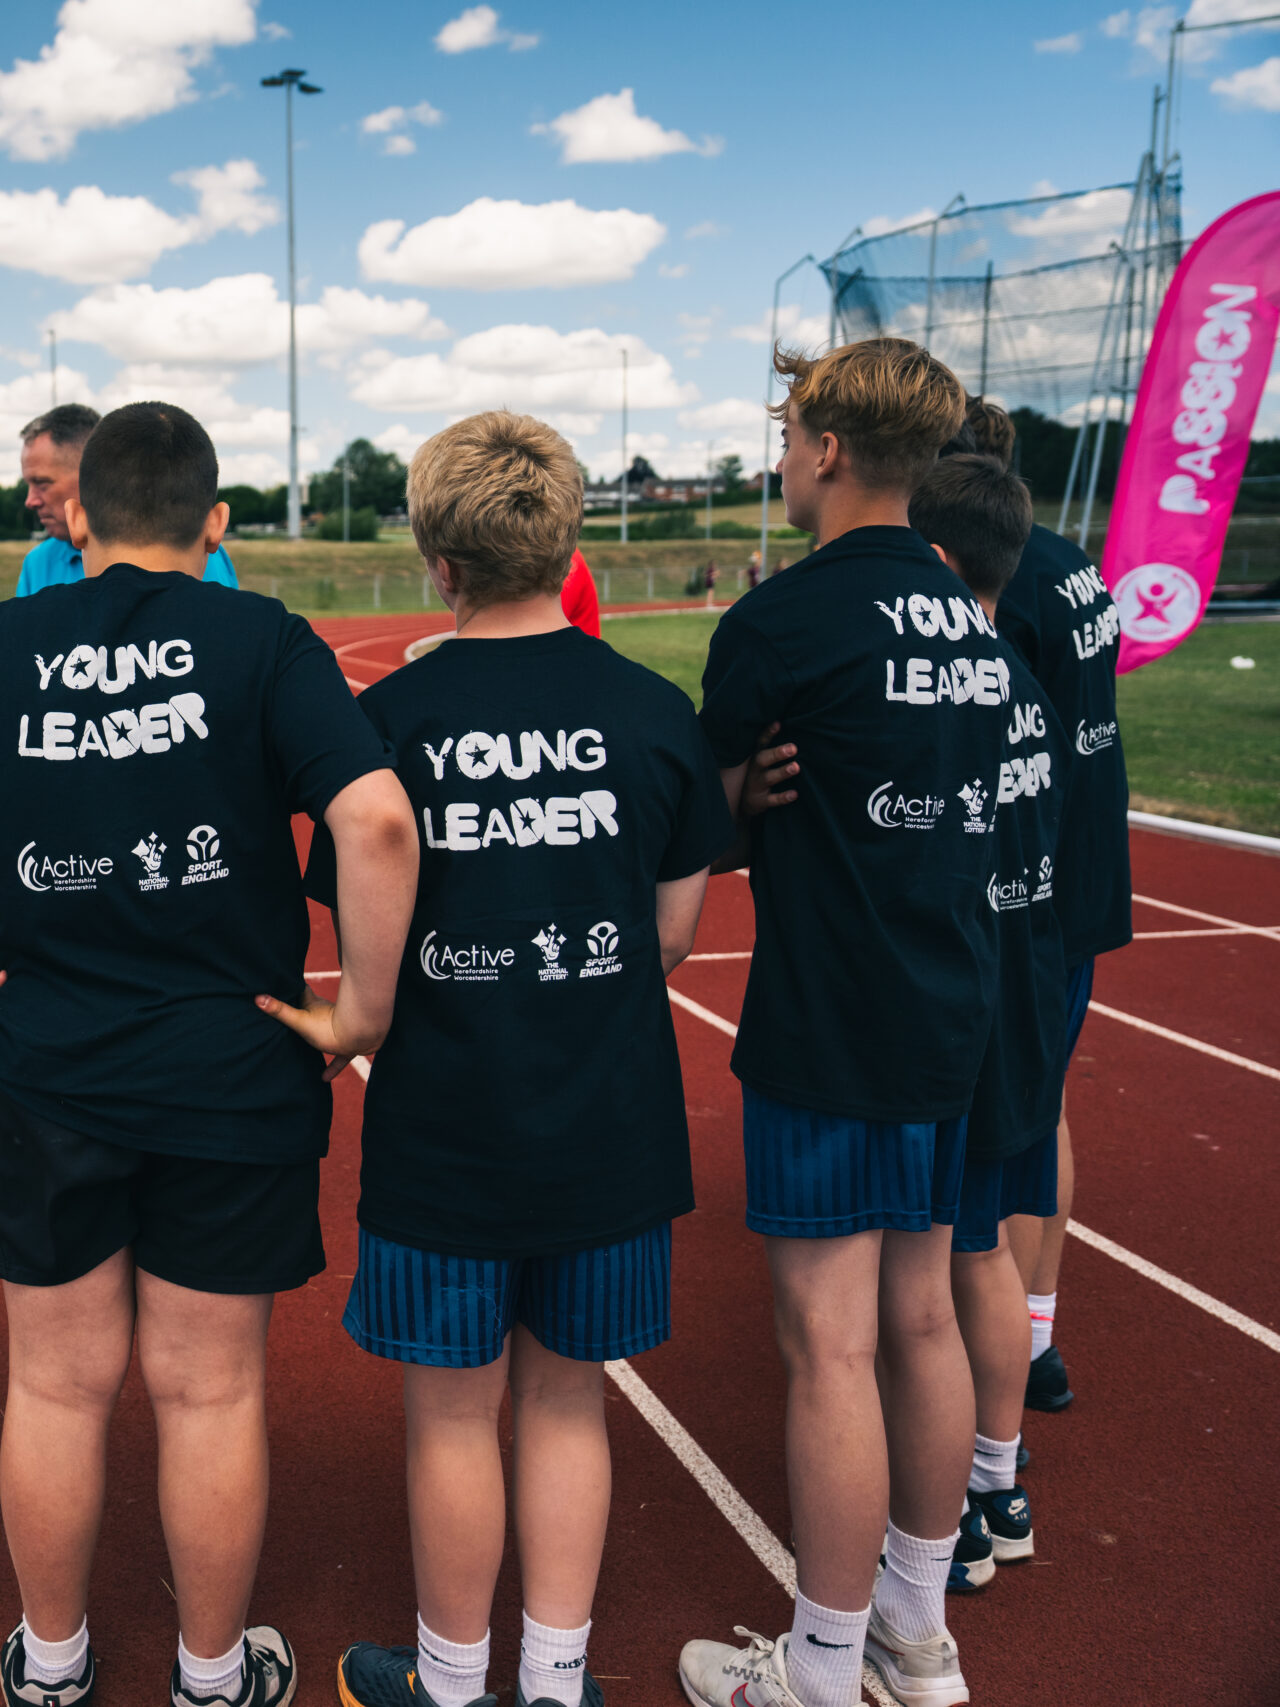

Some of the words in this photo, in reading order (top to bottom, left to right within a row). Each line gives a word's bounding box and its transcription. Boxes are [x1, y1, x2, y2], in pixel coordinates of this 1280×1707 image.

[1159, 283, 1258, 515] PASSION
[34, 639, 194, 694] YOUNG
[18, 692, 209, 761] LEADER
[423, 728, 607, 780] YOUNG
[423, 790, 619, 851] LEADER
[41, 854, 114, 878] Active
[188, 859, 222, 874] SPORT
[54, 877, 97, 885] Herefordshire
[139, 876, 170, 886] NATIONAL
[181, 867, 230, 885] ENGLAND
[140, 883, 168, 891] LOTTERY
[441, 945, 515, 966] Active
[585, 956, 618, 968] SPORT
[538, 968, 568, 976] NATIONAL
[579, 963, 623, 978] ENGLAND
